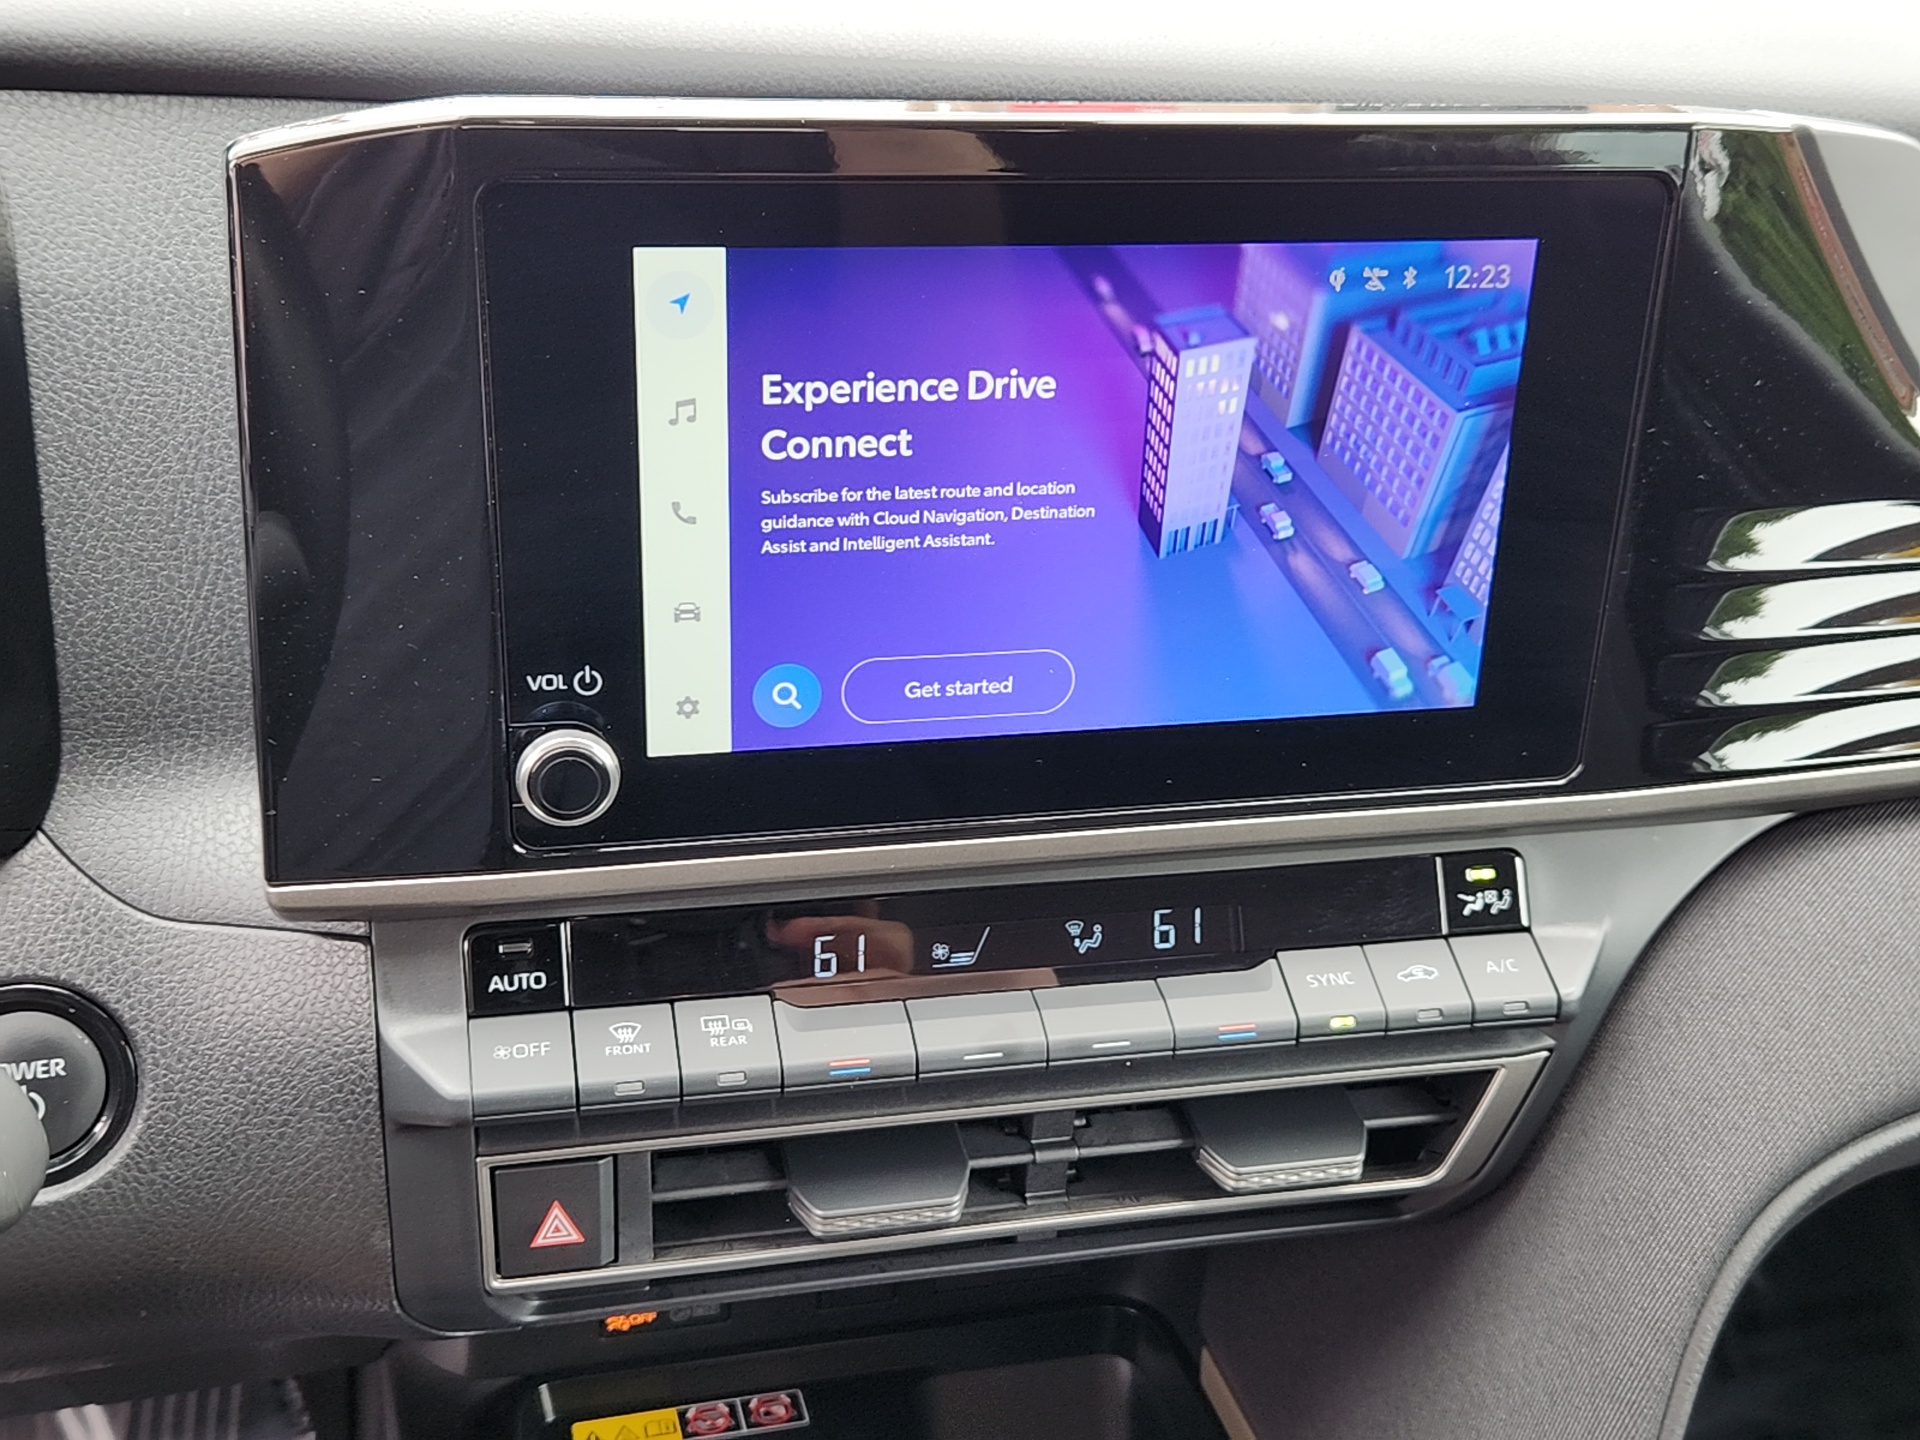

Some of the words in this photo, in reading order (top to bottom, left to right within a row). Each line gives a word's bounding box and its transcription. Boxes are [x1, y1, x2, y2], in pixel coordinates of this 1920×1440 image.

[1445, 264, 1511, 289] 12:23
[762, 371, 959, 412] Experience
[968, 368, 1057, 400] Drive
[761, 429, 913, 460] Connect
[761, 488, 839, 504] Subscribe
[841, 487, 863, 502] for
[866, 486, 892, 501] the
[895, 485, 937, 500] latest
[940, 484, 981, 499] route
[983, 483, 1013, 498] and
[1016, 481, 1076, 496] location
[761, 515, 834, 533] guidance
[837, 513, 870, 528] with
[873, 510, 920, 526] Cloud
[923, 507, 1008, 526] Navigation,
[1011, 505, 1095, 521] Destination
[761, 539, 806, 554] Assist
[809, 538, 840, 553] and
[843, 535, 920, 553] Intelligent
[923, 532, 995, 549] Assistant.
[526, 672, 568, 692] VOL
[904, 680, 940, 699] Get
[944, 675, 1013, 697] started
[1153, 907, 1201, 950] 61
[813, 933, 867, 979] 61
[1485, 958, 1519, 975] A/C
[488, 971, 547, 993] AUTO
[1305, 970, 1355, 988] SYNC
[512, 1042, 551, 1059] OFF
[604, 1042, 651, 1057] FRONT
[709, 1033, 748, 1047] REAR
